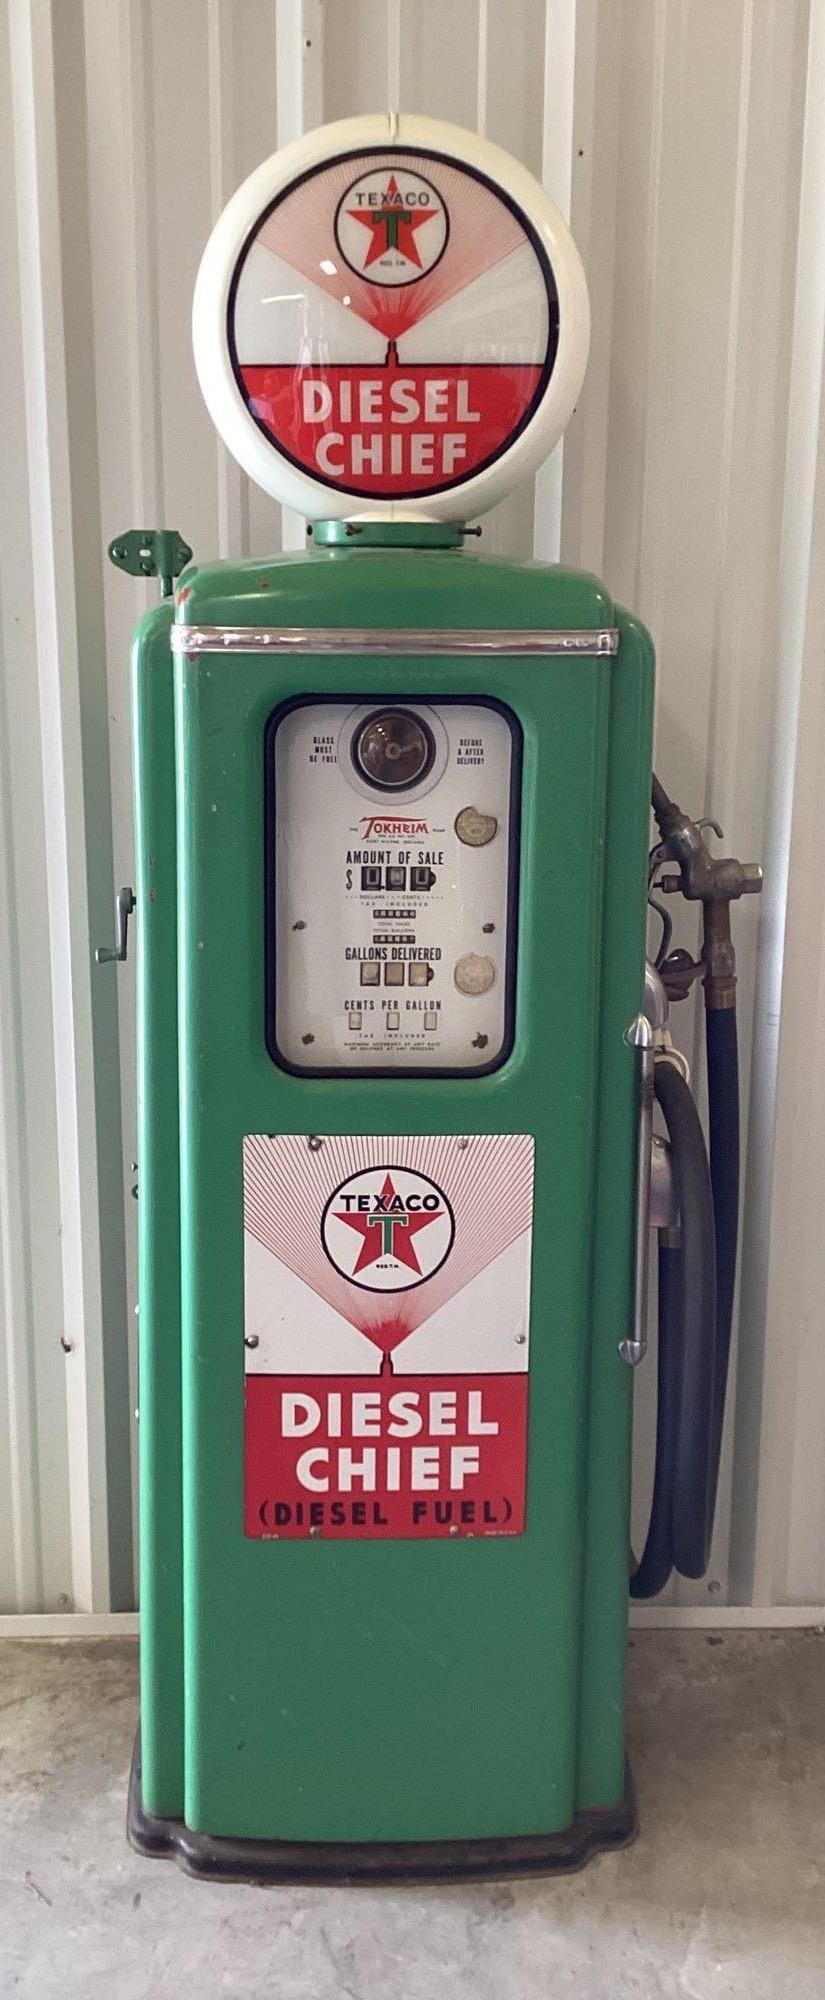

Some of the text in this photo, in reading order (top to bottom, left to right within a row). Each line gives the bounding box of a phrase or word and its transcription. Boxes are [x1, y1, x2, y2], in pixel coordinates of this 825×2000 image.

[355, 192, 430, 206] TEXACO
[372, 211, 412, 249] T
[302, 379, 481, 424] DIESEL
[315, 432, 467, 476] CHIEF
[313, 736, 334, 744] GLASS
[315, 746, 332, 754] MUST
[465, 748, 484, 756] AFTER
[309, 755, 337, 763] BE FULL
[456, 757, 484, 765] DELIVERY
[359, 816, 429, 840] TOKHEIM
[346, 851, 444, 865] AMOUNT OF SALE
[345, 947, 442, 960] GALLONS DELIVERED
[344, 1000, 442, 1010] CENTS PER GALLON
[340, 1194, 440, 1212] TEXACO
[368, 1215, 409, 1255] T
[281, 1391, 499, 1438] DIESEL
[296, 1446, 480, 1492] CHIEF
[258, 1497, 513, 1526] (DIESEL FUEL)
